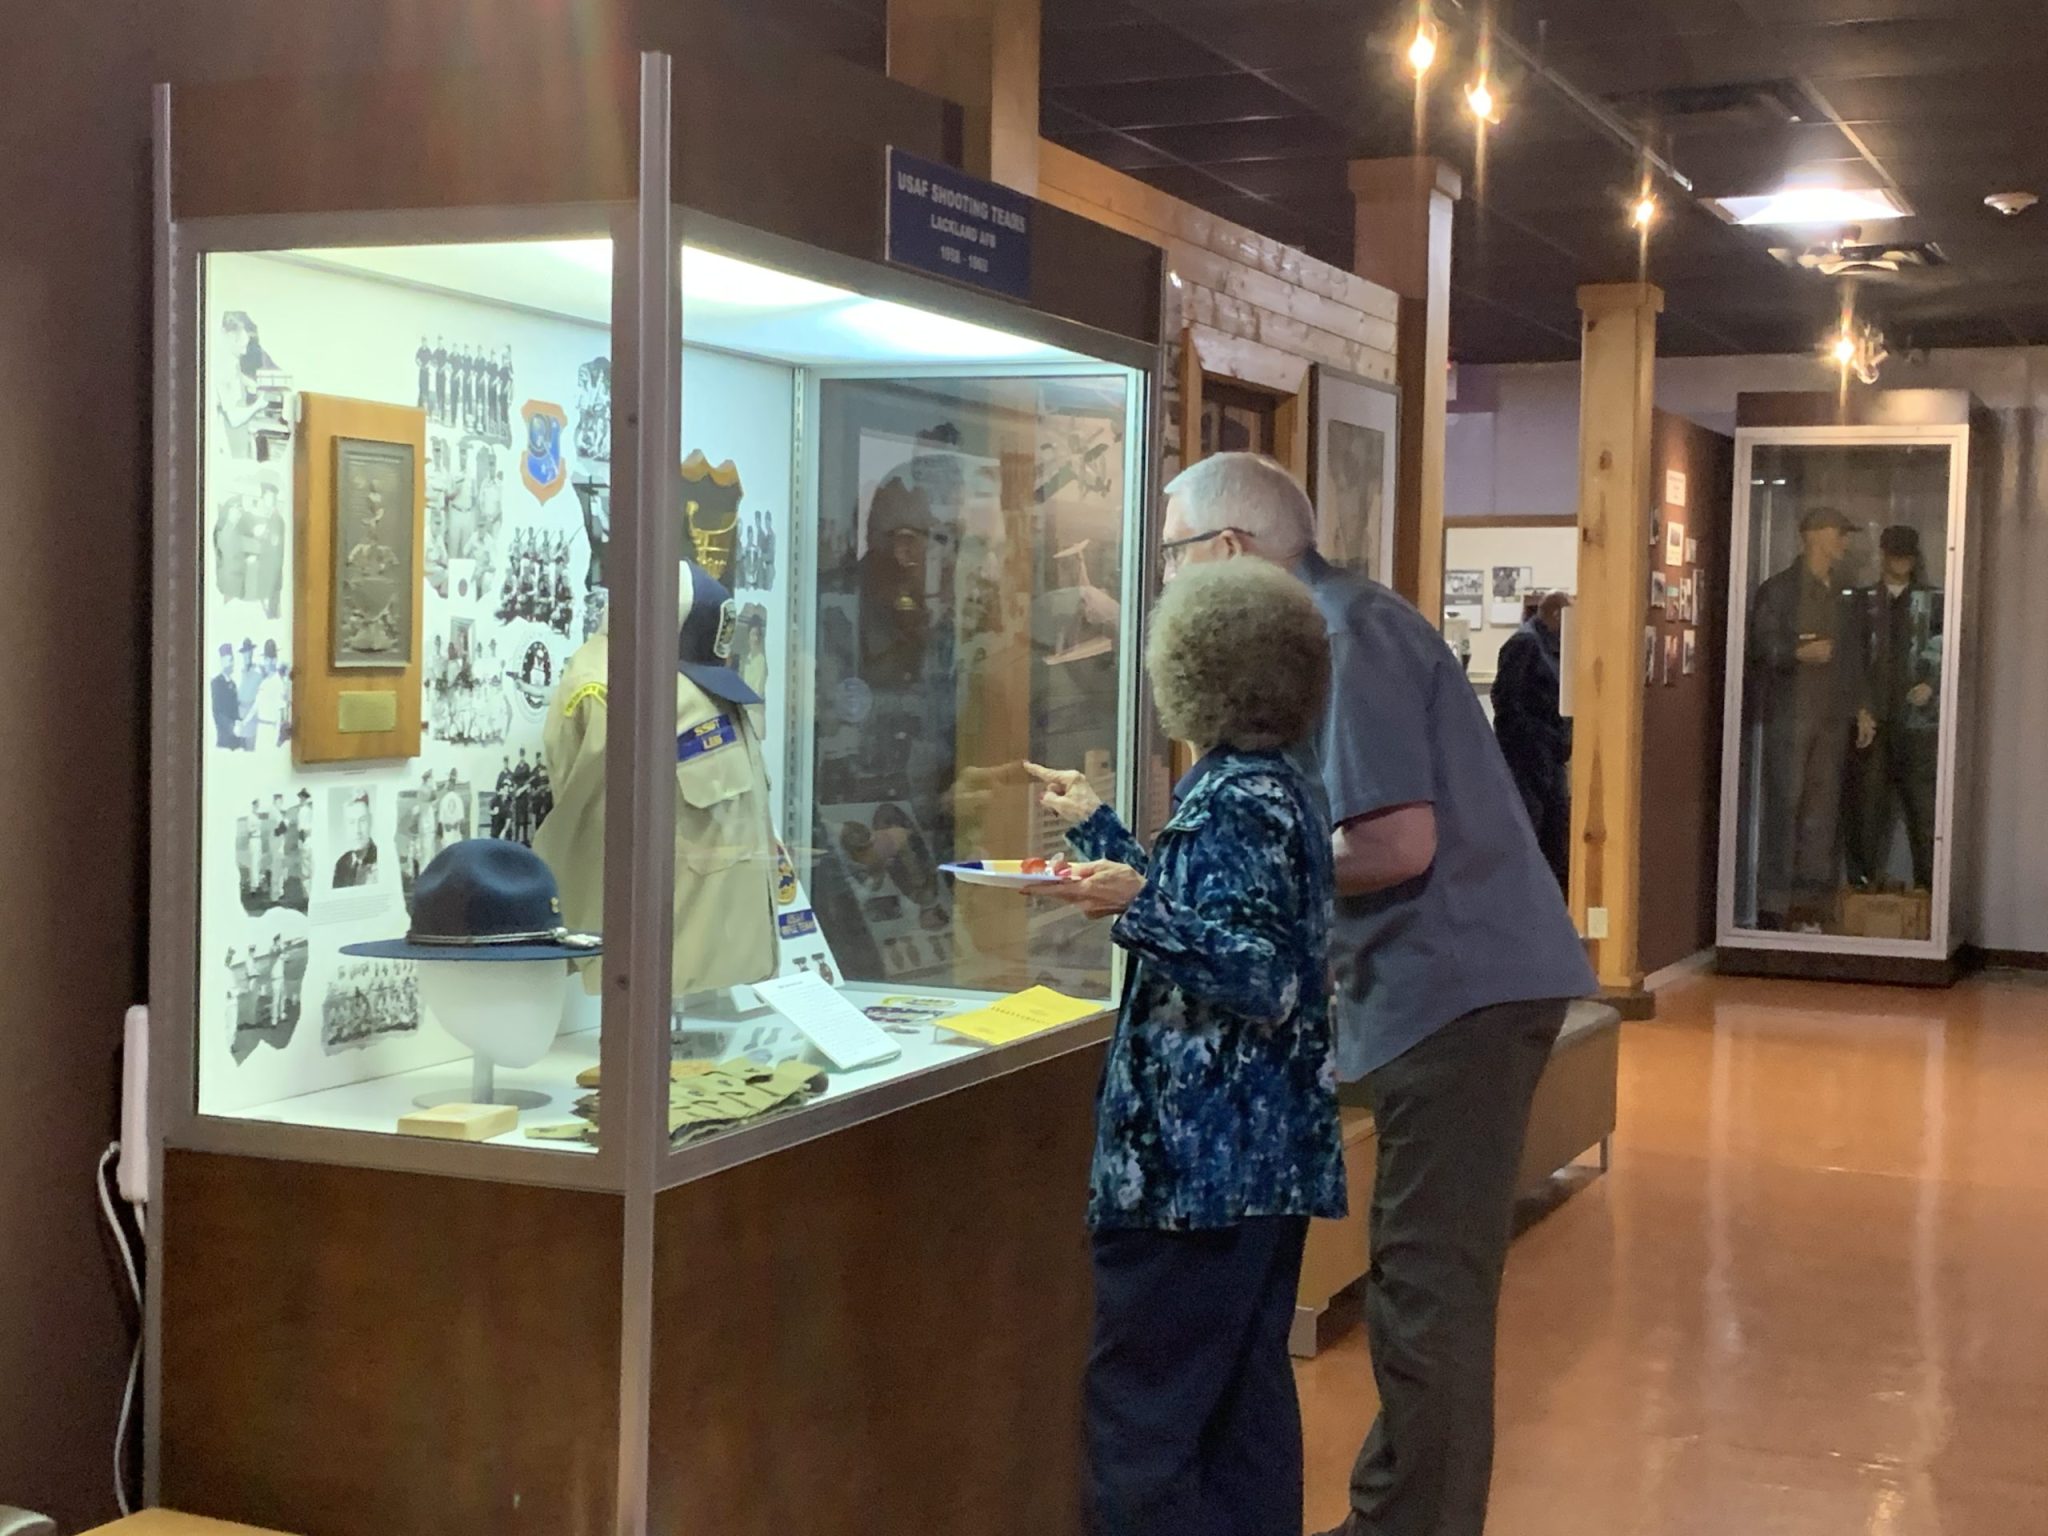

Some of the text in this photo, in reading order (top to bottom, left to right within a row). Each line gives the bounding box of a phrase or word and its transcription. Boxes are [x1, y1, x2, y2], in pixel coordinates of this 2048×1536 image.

[898, 171, 928, 197] USAF
[931, 183, 988, 219] SHOOTING
[931, 214, 978, 242] LACKLAND
